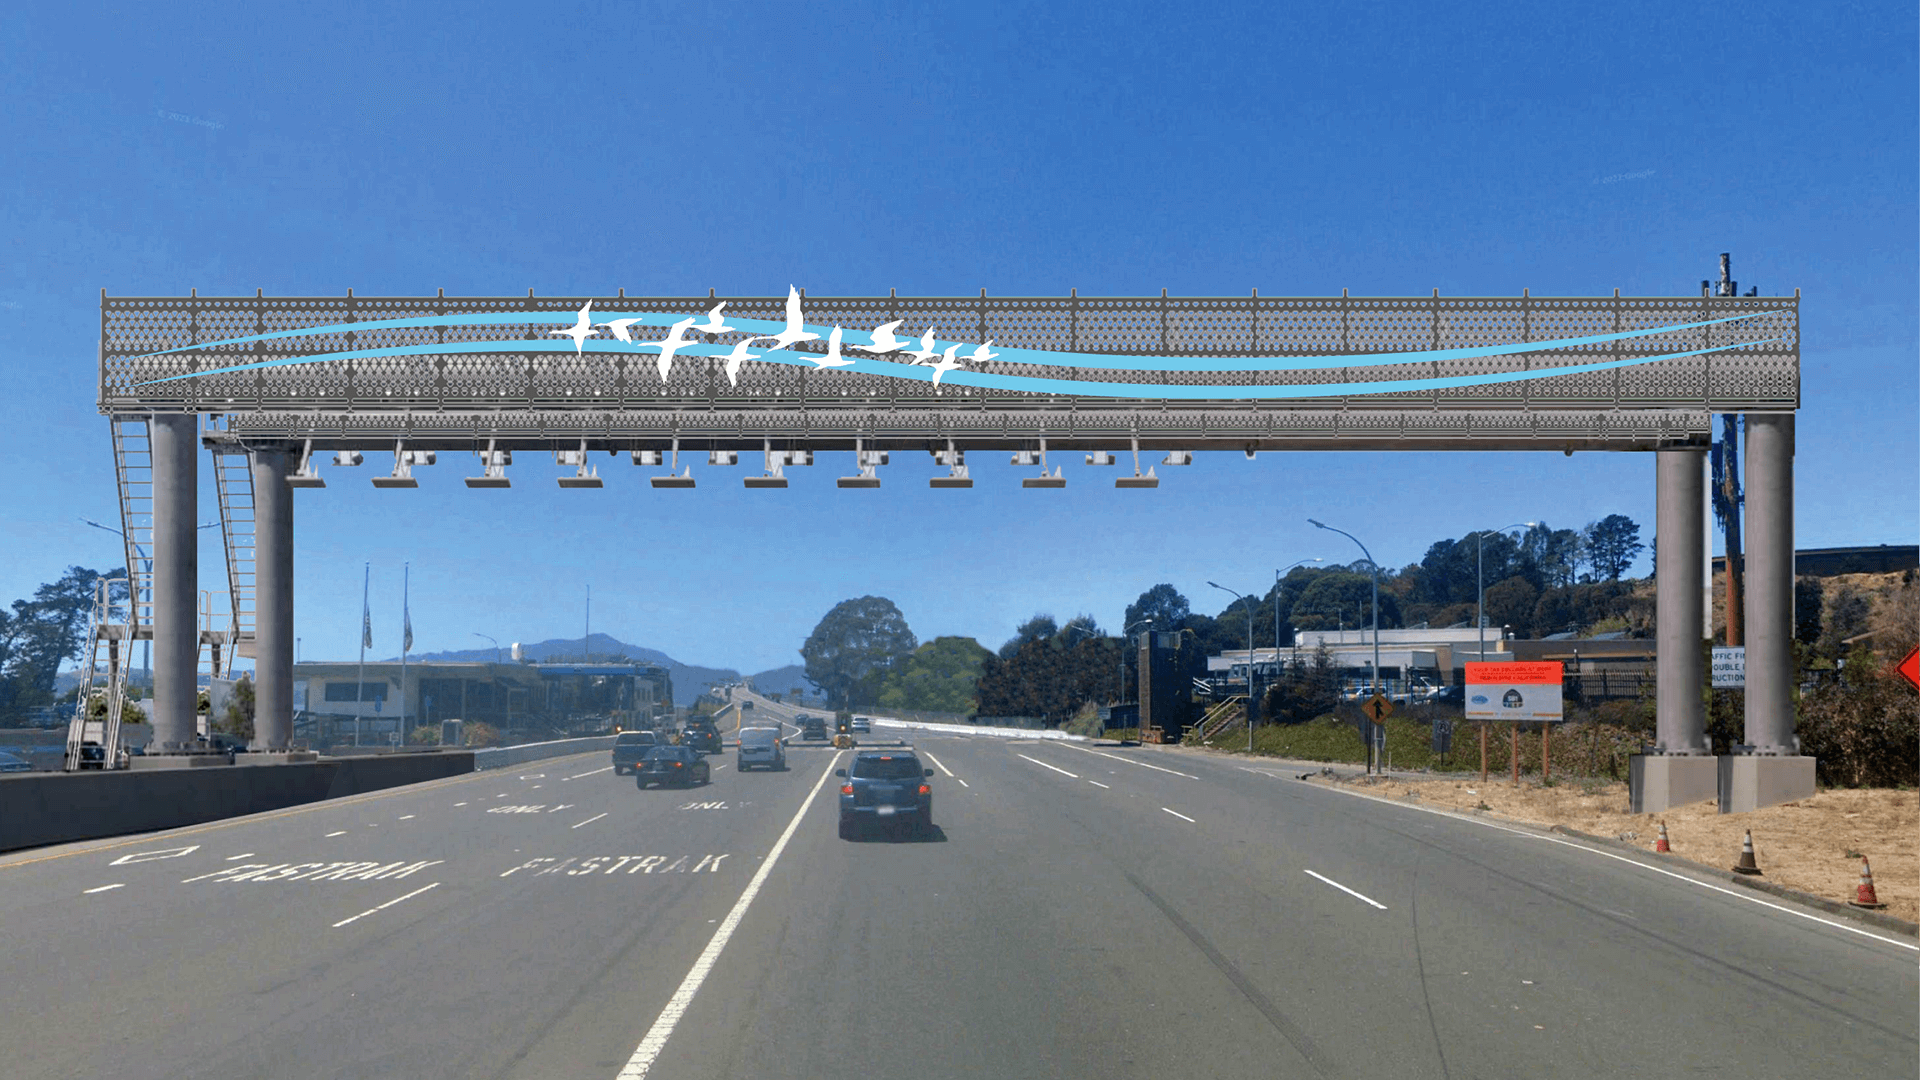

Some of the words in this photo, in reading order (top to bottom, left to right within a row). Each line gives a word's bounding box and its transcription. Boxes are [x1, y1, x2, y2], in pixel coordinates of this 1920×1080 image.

[1712, 663, 1740, 671] OUBLE
[181, 860, 445, 883] FASTRAK
[500, 853, 730, 877] FASTRAK
